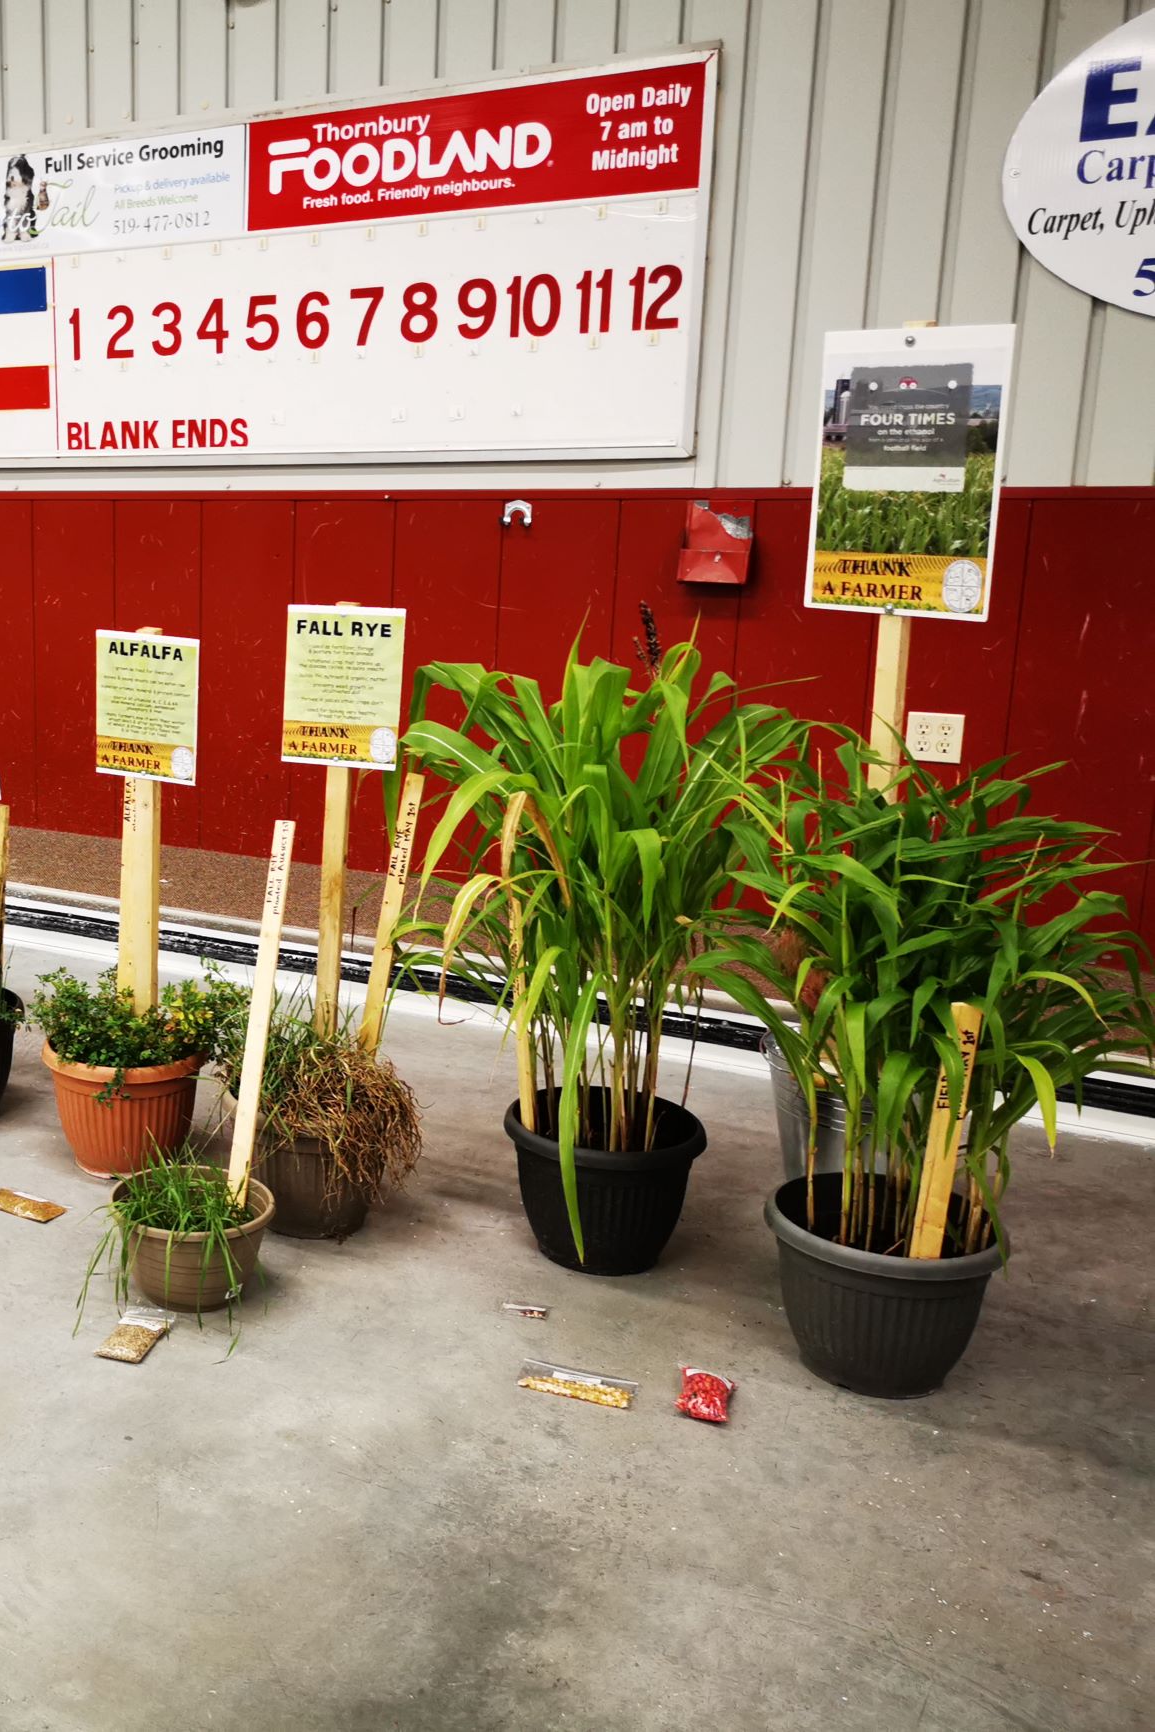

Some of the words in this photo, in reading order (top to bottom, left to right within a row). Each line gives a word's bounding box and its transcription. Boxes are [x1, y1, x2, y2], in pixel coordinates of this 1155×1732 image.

[585, 89, 639, 116] Open
[641, 84, 693, 109] Daily
[311, 114, 430, 143] Thornbury
[600, 121, 612, 141] 7
[616, 121, 648, 139] am
[654, 115, 674, 136] to
[45, 154, 72, 174] Full
[77, 149, 134, 170] Service
[138, 138, 224, 162] Grooming
[268, 121, 553, 195] FOODLAND
[591, 142, 679, 172] Midnight
[152, 178, 187, 192] delivery
[189, 172, 231, 187] available
[302, 194, 338, 209] Fresh
[340, 191, 374, 207] food.
[377, 183, 431, 204] Friendly
[432, 176, 516, 198] neighbours.
[127, 196, 153, 209] Breeds
[154, 193, 198, 207] Welcome
[1028, 203, 1105, 240] Carpet,
[68, 307, 82, 361] 1
[106, 305, 135, 360] 2
[151, 300, 182, 357] 3
[196, 297, 229, 355] 4
[245, 294, 280, 352] 5
[295, 291, 330, 350] 6
[349, 286, 385, 347] 7
[399, 281, 439, 343] 8
[456, 278, 498, 340] 9
[506, 273, 562, 339] 10
[576, 268, 614, 335] 11
[628, 263, 684, 332] 12
[860, 412, 904, 426] FOUR
[908, 412, 956, 425] TIMES
[66, 419, 161, 451] BLANK
[172, 417, 249, 449] ENDS
[877, 428, 888, 436] on
[889, 428, 902, 436] the
[904, 427, 936, 436] ethanol
[839, 559, 911, 577] THANK
[822, 581, 835, 595] A
[841, 581, 923, 601] FARMER
[296, 619, 344, 637] FALL
[351, 621, 392, 637] RYE
[108, 641, 183, 662] ALFALFA
[300, 726, 350, 739] THANK
[111, 741, 154, 756] THANK
[289, 741, 298, 750] A
[301, 741, 357, 755] FARMER
[101, 754, 109, 763] A
[113, 755, 162, 770] FARMER
[402, 821, 412, 842] MAY
[398, 847, 409, 885] planted
[961, 1029, 975, 1045] 1st
